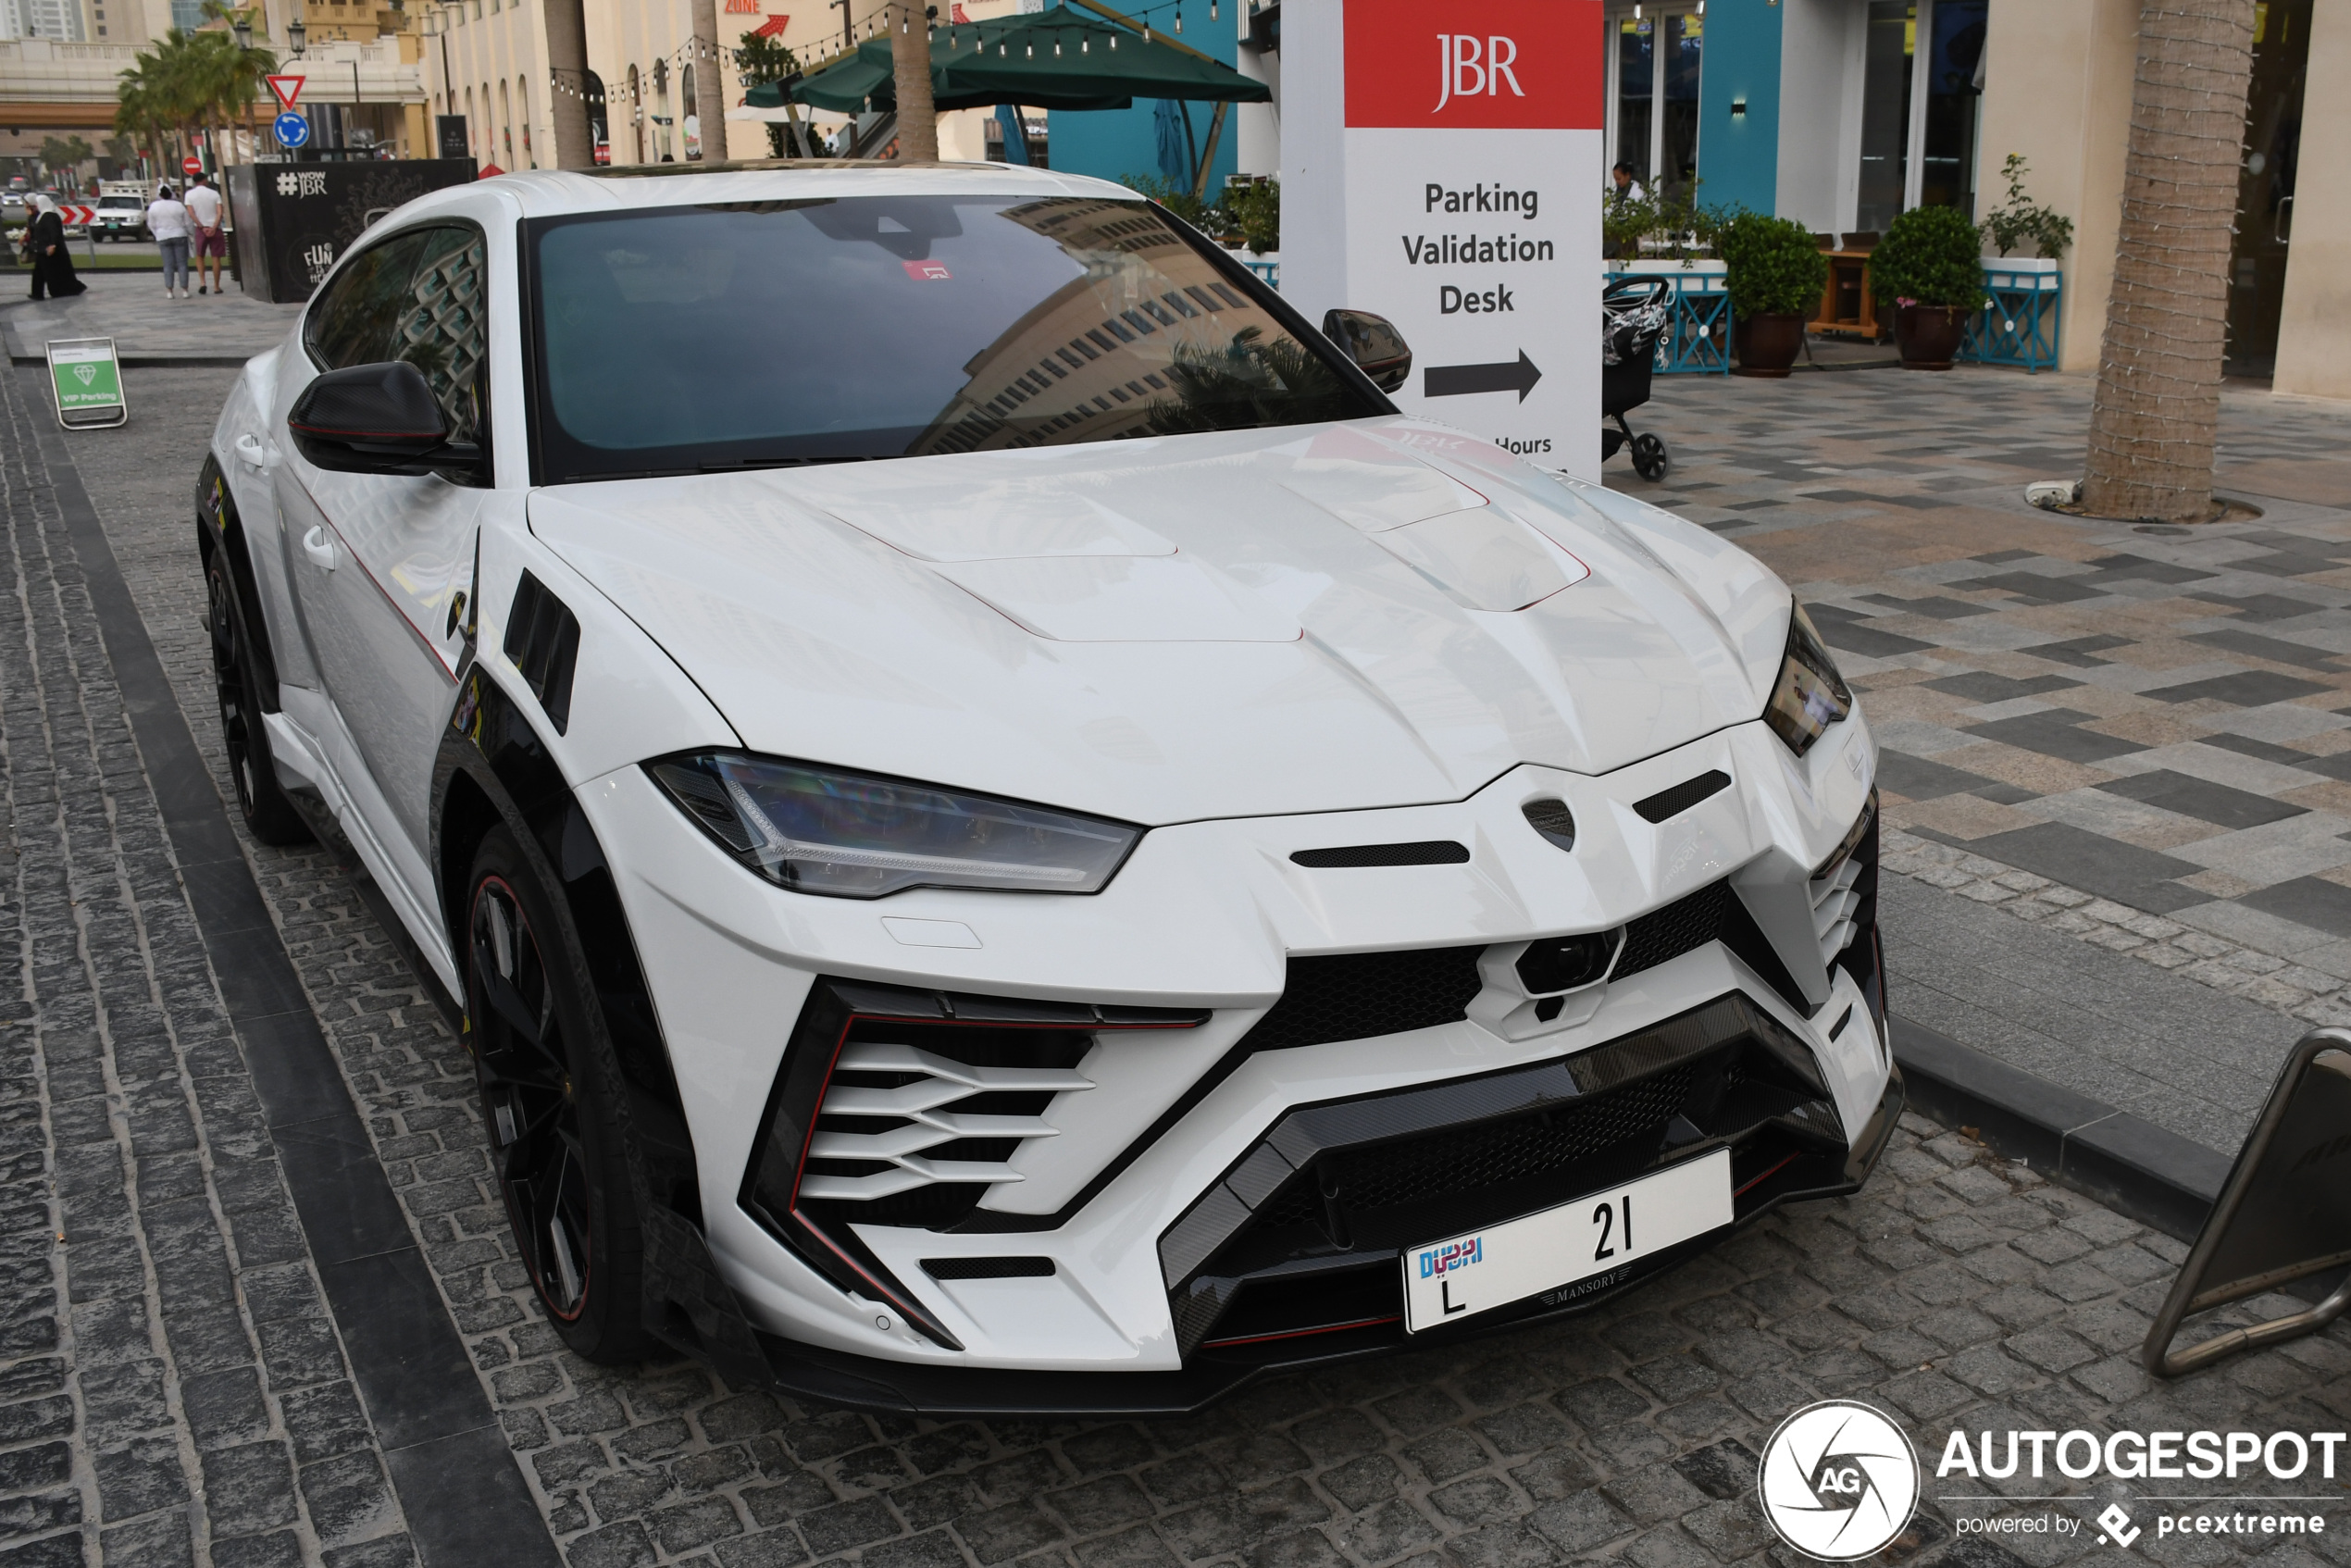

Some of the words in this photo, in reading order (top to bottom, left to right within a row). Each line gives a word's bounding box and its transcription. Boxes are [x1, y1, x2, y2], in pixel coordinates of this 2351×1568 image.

[1432, 34, 1525, 113] JBR
[298, 171, 326, 180] WOW
[299, 180, 328, 199] JBR
[1425, 182, 1538, 220] Parking
[304, 244, 333, 267] FUN
[1401, 233, 1554, 265] Validation
[1440, 283, 1514, 315] Desk
[63, 393, 80, 402] VIP
[81, 392, 117, 402] Parking
[1495, 437, 1552, 455] Hours
[1592, 1195, 1632, 1262] 21
[1441, 1280, 1466, 1315] L
[1556, 1272, 1617, 1303] MANSORY
